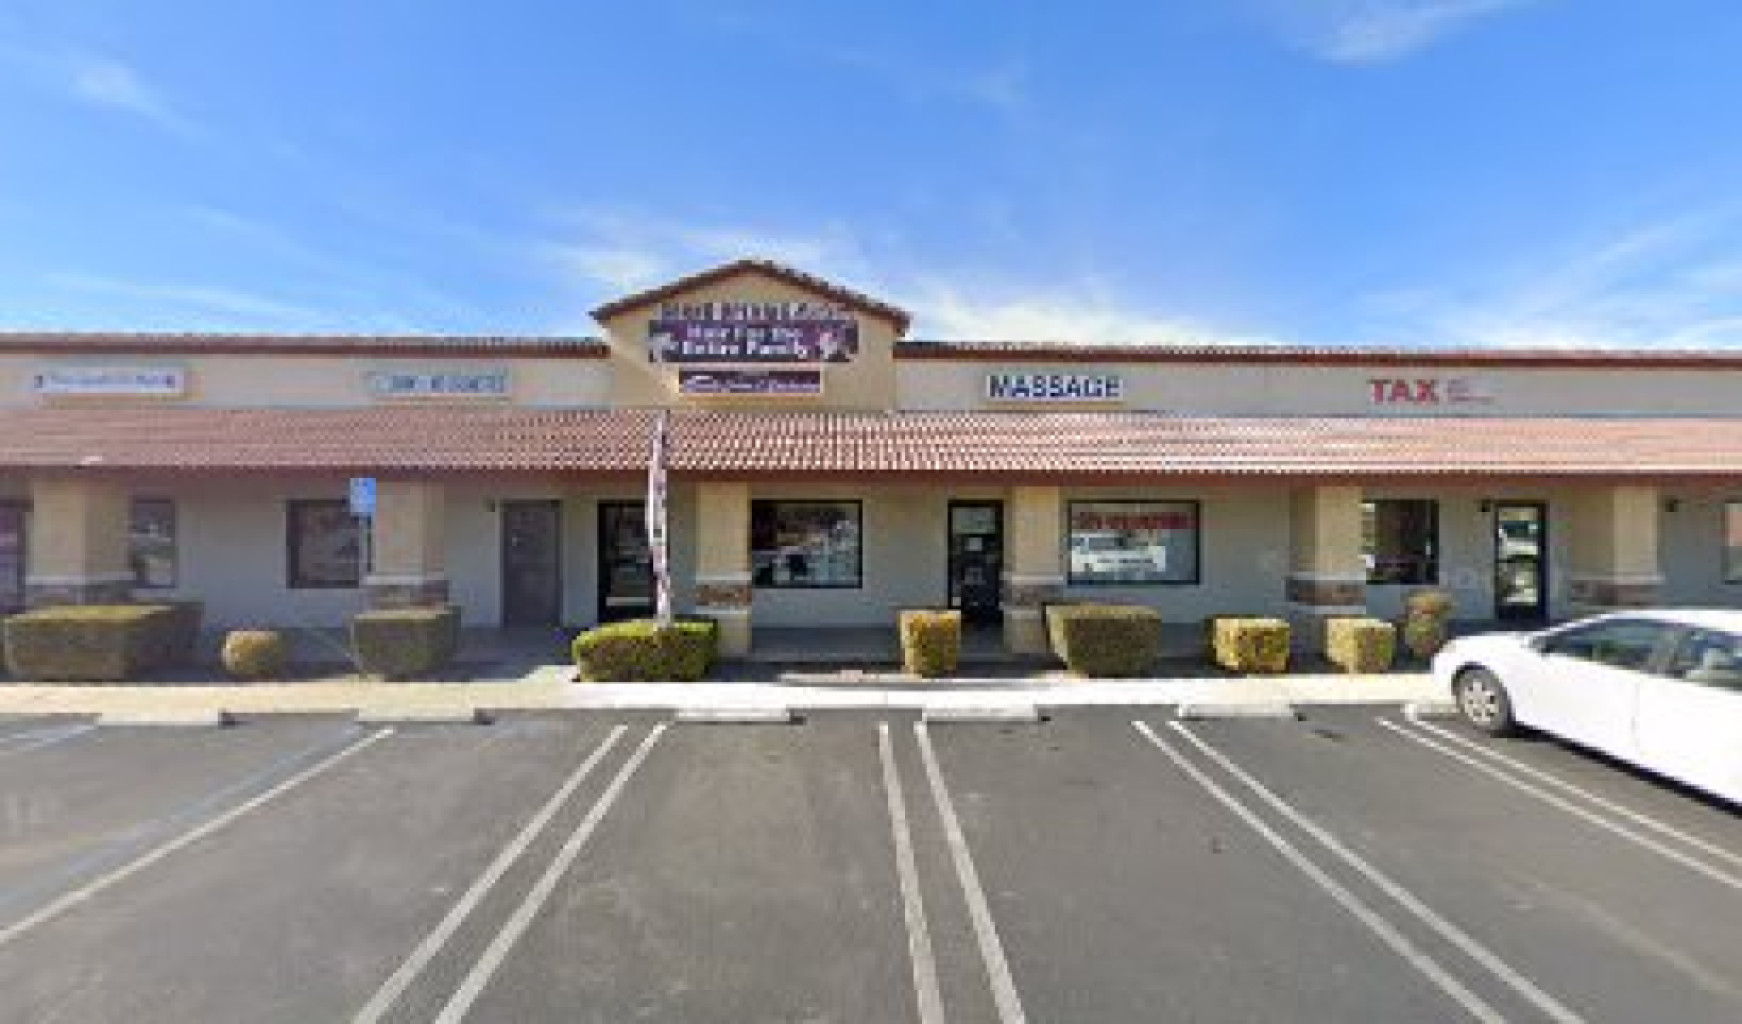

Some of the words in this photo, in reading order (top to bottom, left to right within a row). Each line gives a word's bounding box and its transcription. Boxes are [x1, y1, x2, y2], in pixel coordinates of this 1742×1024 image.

[682, 340, 740, 355] Entire
[745, 340, 809, 359] Family
[988, 375, 1121, 398] MASSAGE
[1366, 378, 1440, 405] TAX
